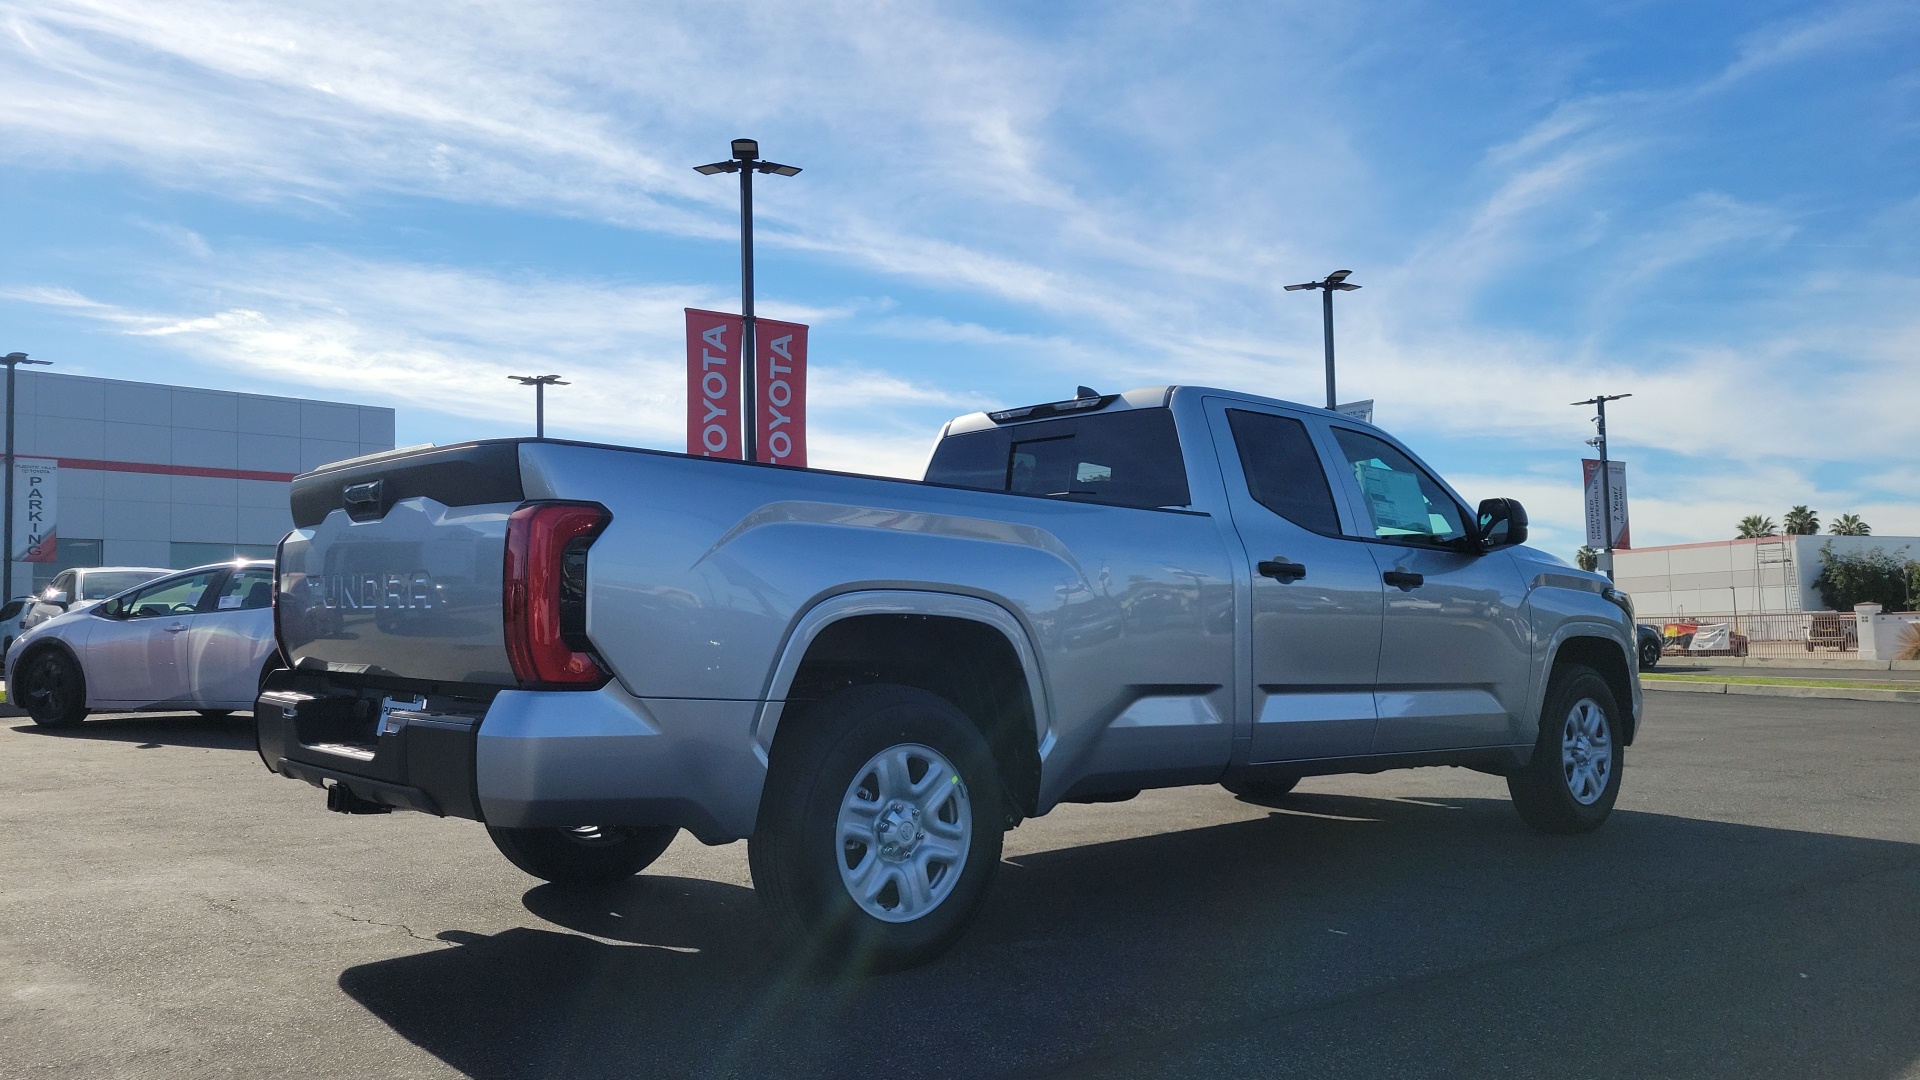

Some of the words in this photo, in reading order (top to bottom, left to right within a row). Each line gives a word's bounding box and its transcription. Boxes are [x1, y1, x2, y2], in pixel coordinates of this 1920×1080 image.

[702, 324, 728, 456] OYOTA
[768, 334, 792, 464] OYOTA
[28, 476, 42, 556] PARKING
